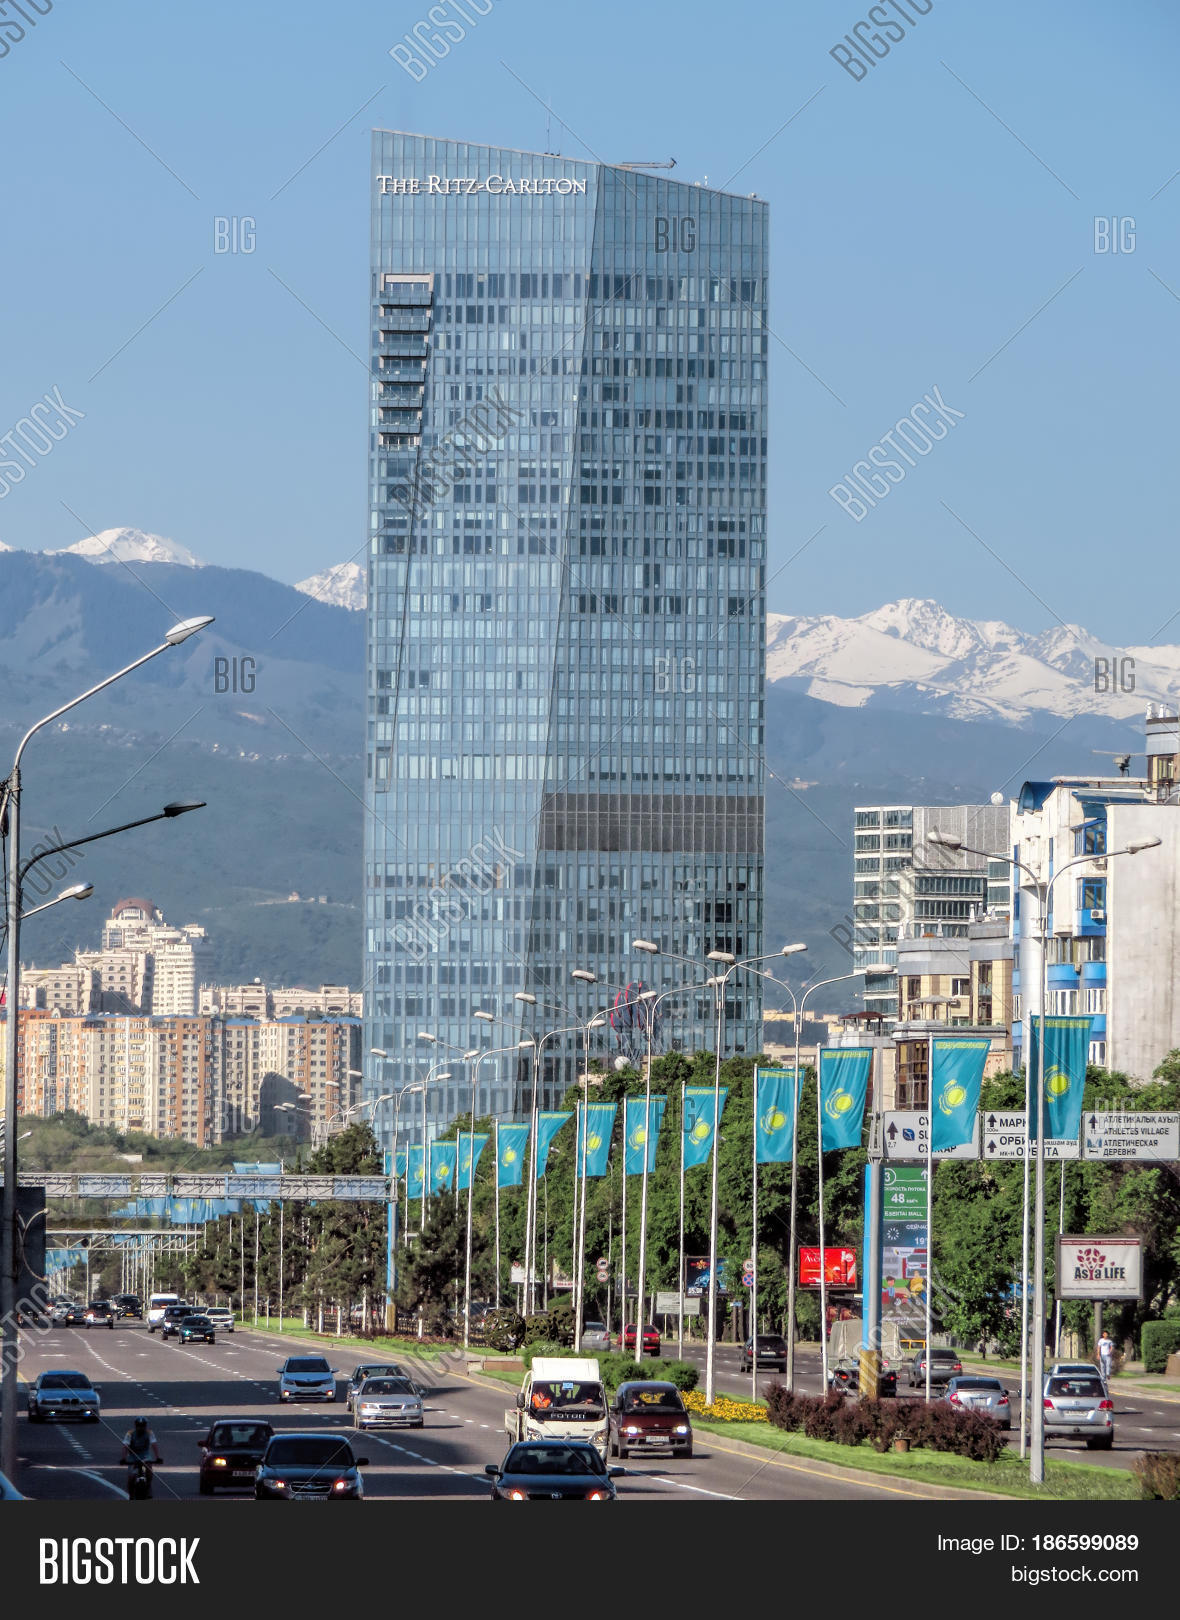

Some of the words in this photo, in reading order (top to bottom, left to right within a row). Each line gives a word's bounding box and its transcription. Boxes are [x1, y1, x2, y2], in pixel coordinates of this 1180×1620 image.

[376, 175, 420, 194] THE
[427, 174, 587, 194] RITZ-CARLTON
[1104, 1127, 1139, 1136] ATHLETES
[1140, 1127, 1170, 1135] VILLAGE
[1104, 1139, 1159, 1147] АТЛЕТИЧЕСКАЯ
[1103, 1148, 1137, 1157] ДЕРЕВНЯ
[890, 1193, 905, 1203] 48
[1104, 1267, 1126, 1279] LIFE
